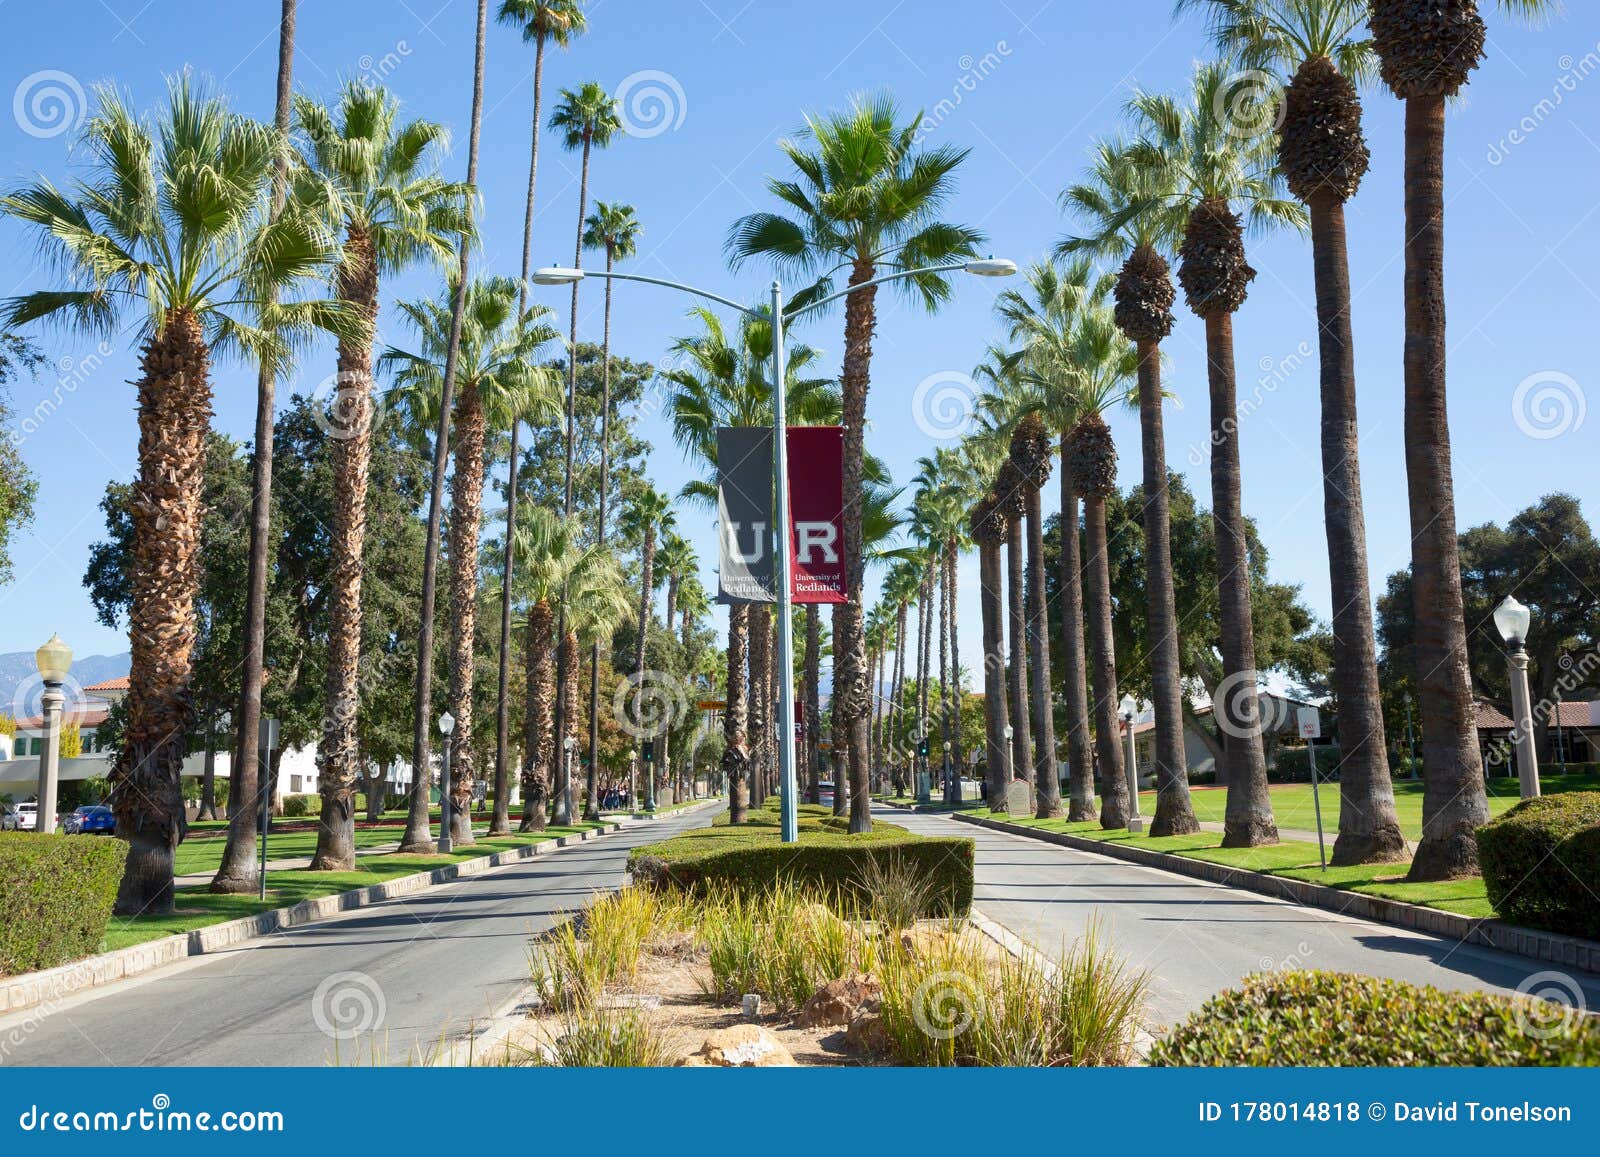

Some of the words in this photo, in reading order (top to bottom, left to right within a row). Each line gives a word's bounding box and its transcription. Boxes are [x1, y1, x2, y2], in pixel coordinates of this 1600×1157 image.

[727, 521, 766, 564] U
[795, 521, 839, 564] R
[795, 574, 830, 582] University
[796, 582, 841, 592] Redlands
